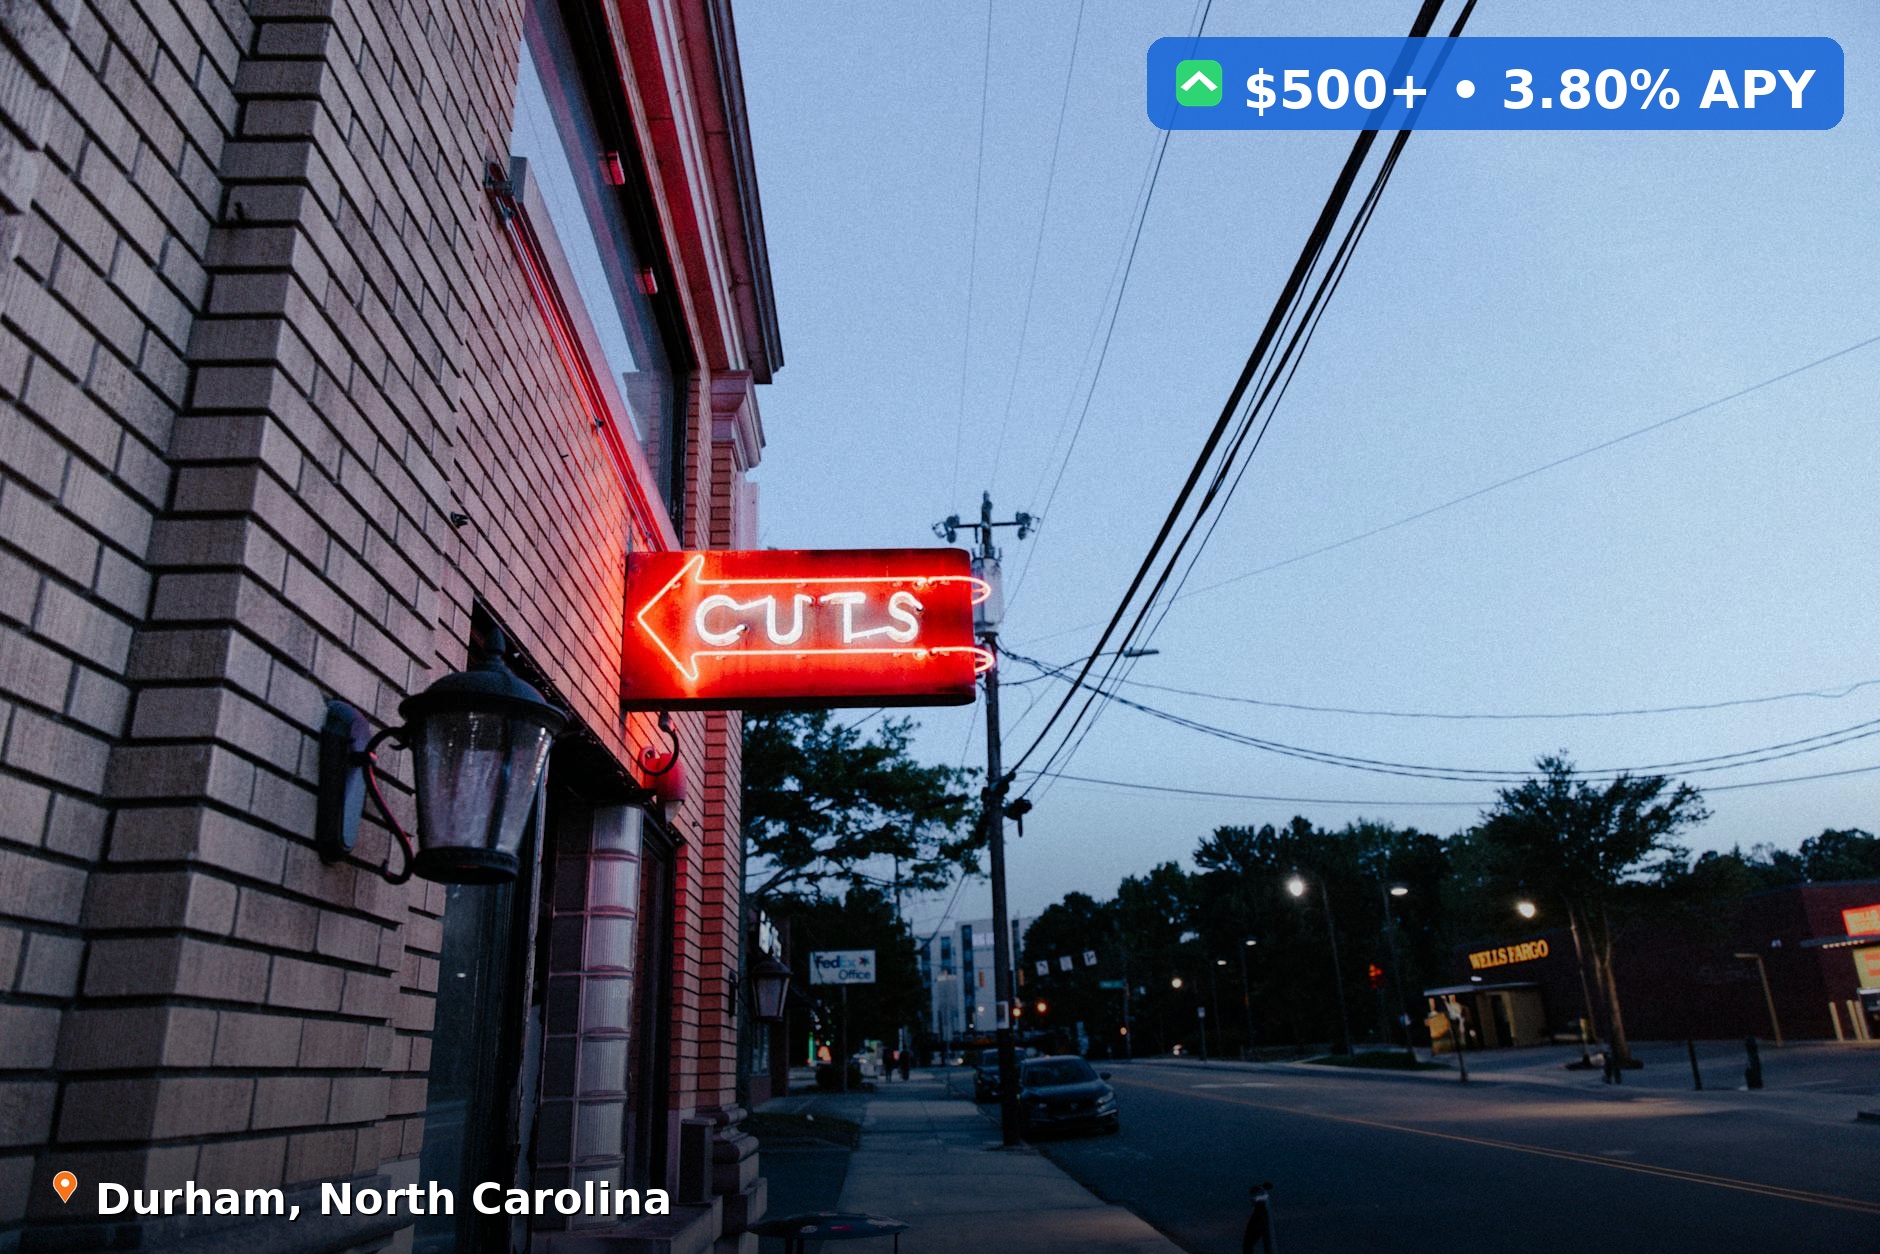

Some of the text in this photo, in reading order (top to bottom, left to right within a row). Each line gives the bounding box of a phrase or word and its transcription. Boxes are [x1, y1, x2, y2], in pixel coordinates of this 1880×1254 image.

[695, 591, 925, 647] CUTS
[1468, 938, 1550, 971] WELLS FARGO
[839, 969, 871, 980] Office
